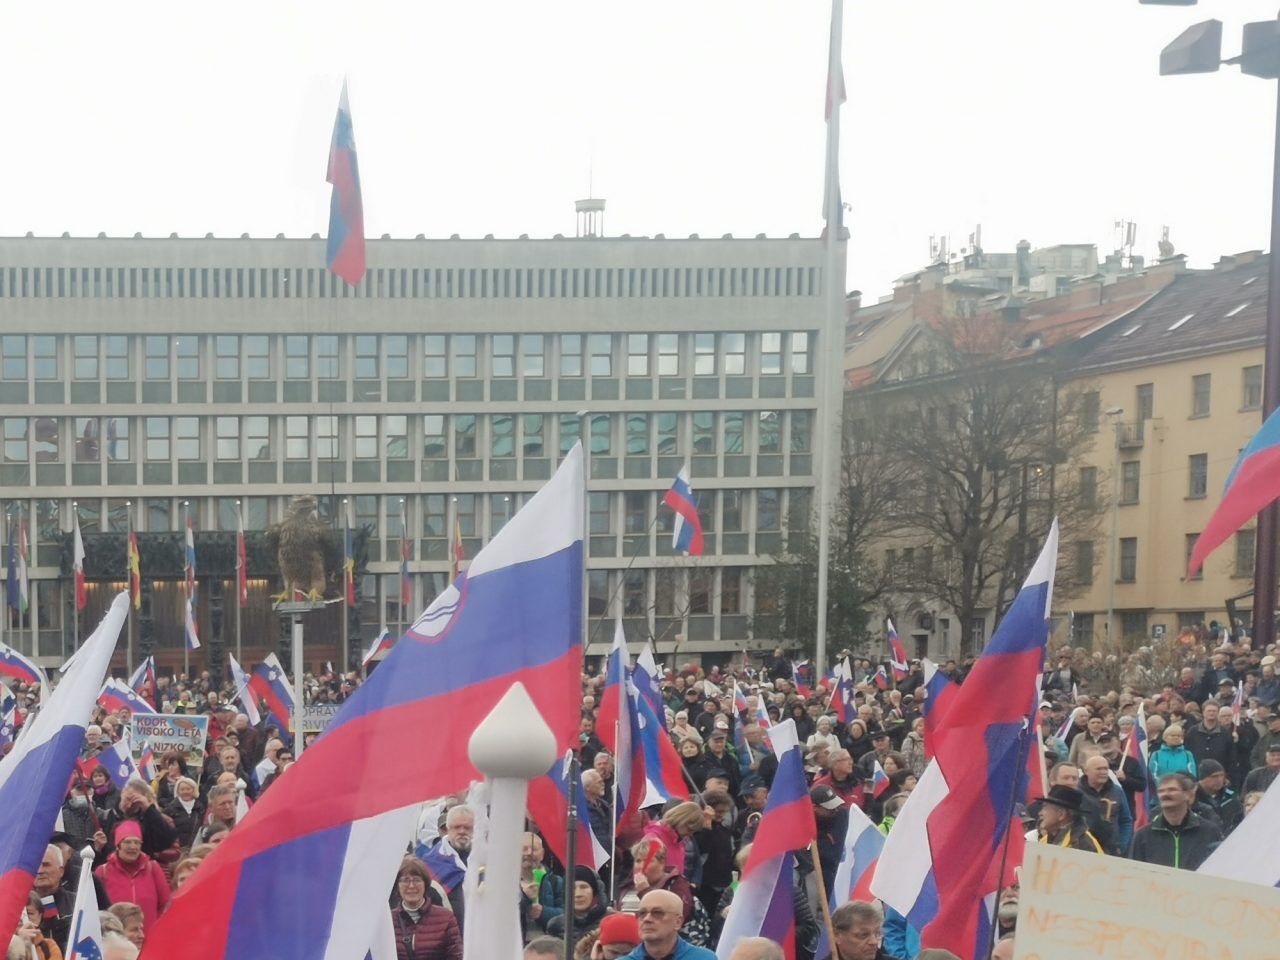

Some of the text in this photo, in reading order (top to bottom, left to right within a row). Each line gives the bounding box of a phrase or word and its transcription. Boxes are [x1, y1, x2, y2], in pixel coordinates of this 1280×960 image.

[136, 717, 167, 727] KDOR
[136, 727, 202, 737] VISOKO LETA
